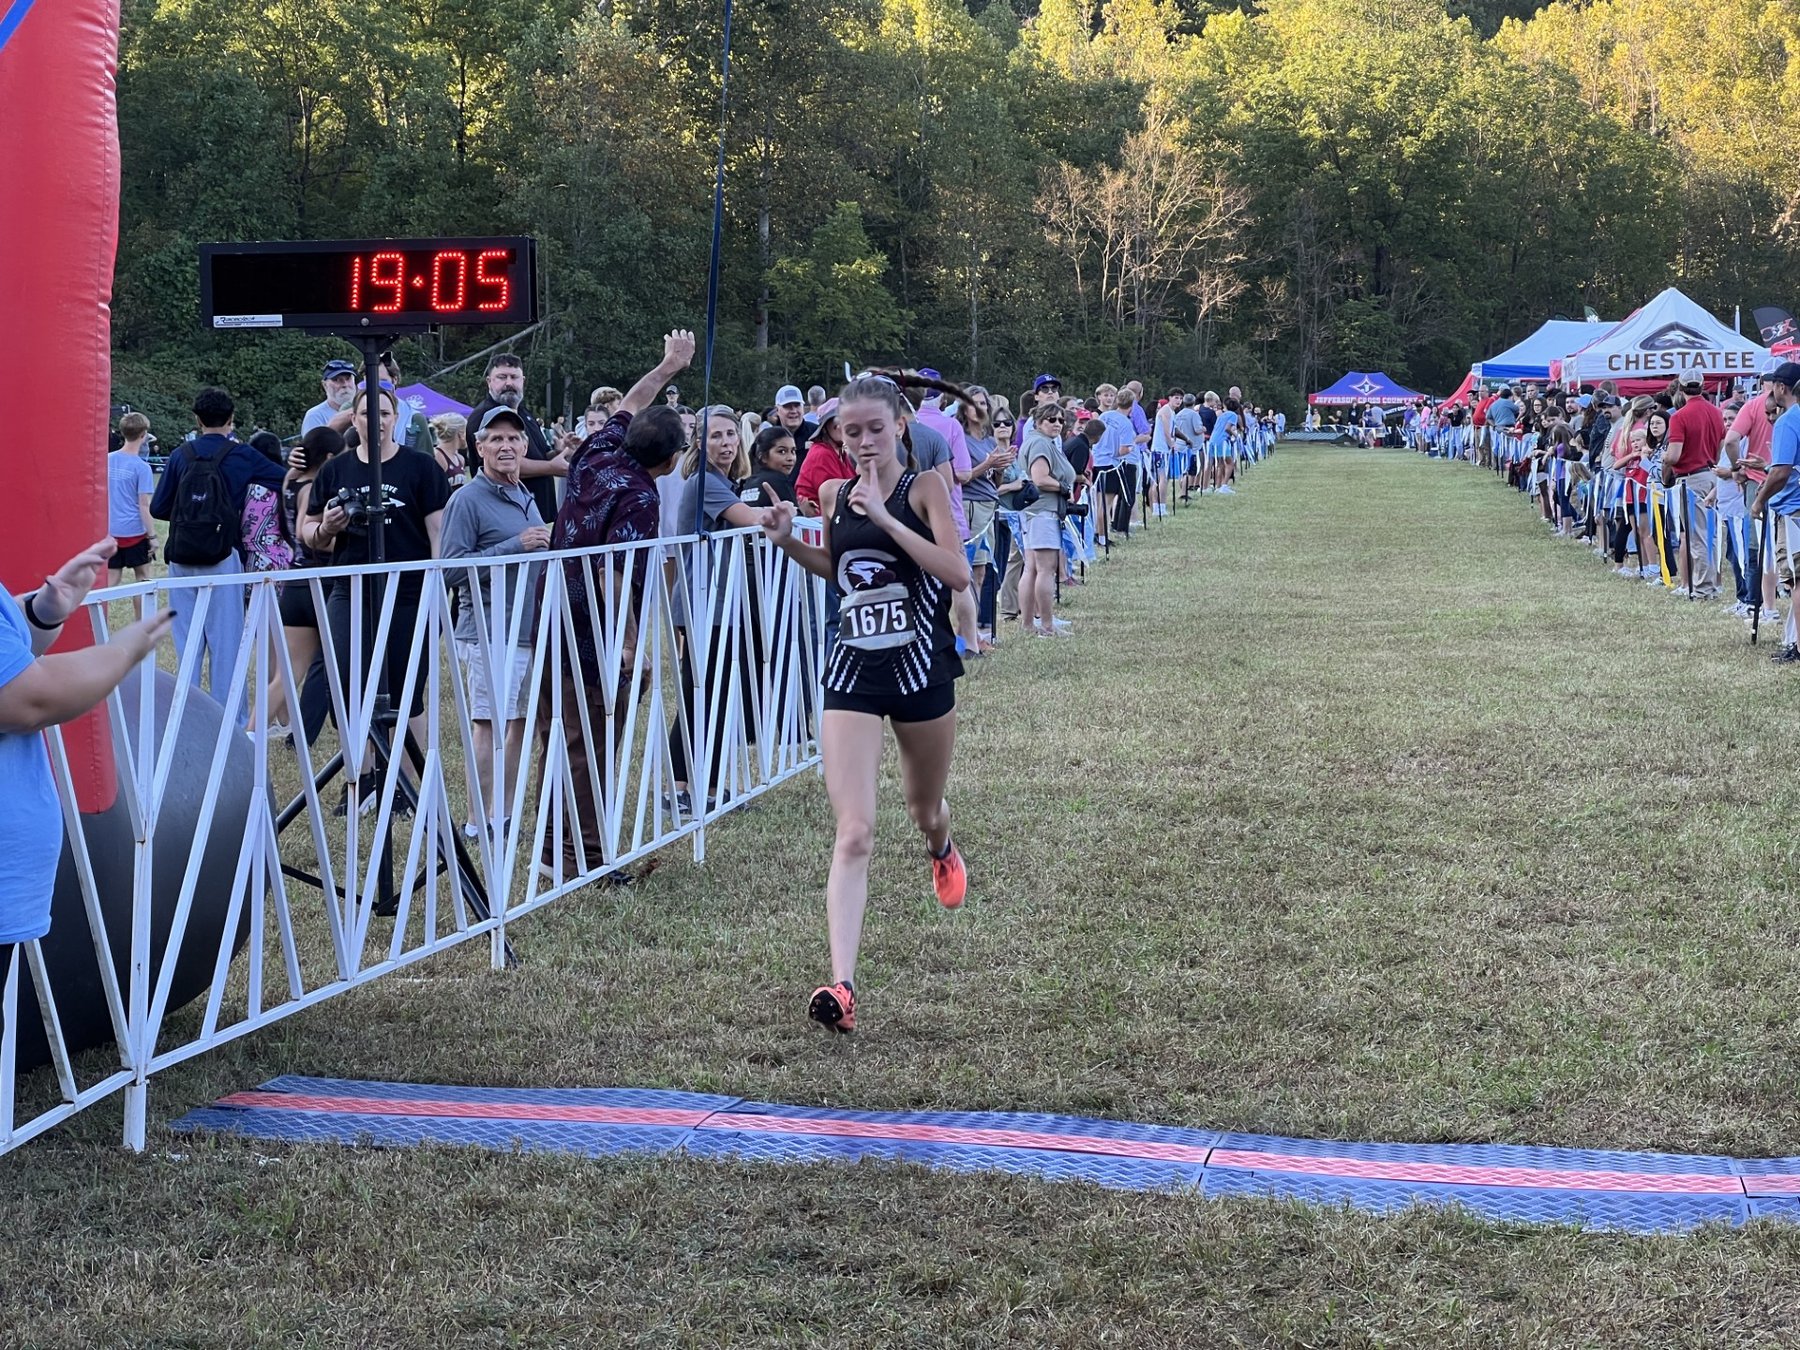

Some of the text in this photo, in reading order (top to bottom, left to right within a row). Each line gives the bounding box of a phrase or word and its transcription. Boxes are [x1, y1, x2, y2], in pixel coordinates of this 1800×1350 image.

[1608, 351, 1755, 371] CHESTATEE
[1315, 396, 1418, 404] JEFFERSON CROSS COUNTRY
[846, 601, 907, 637] 1675
